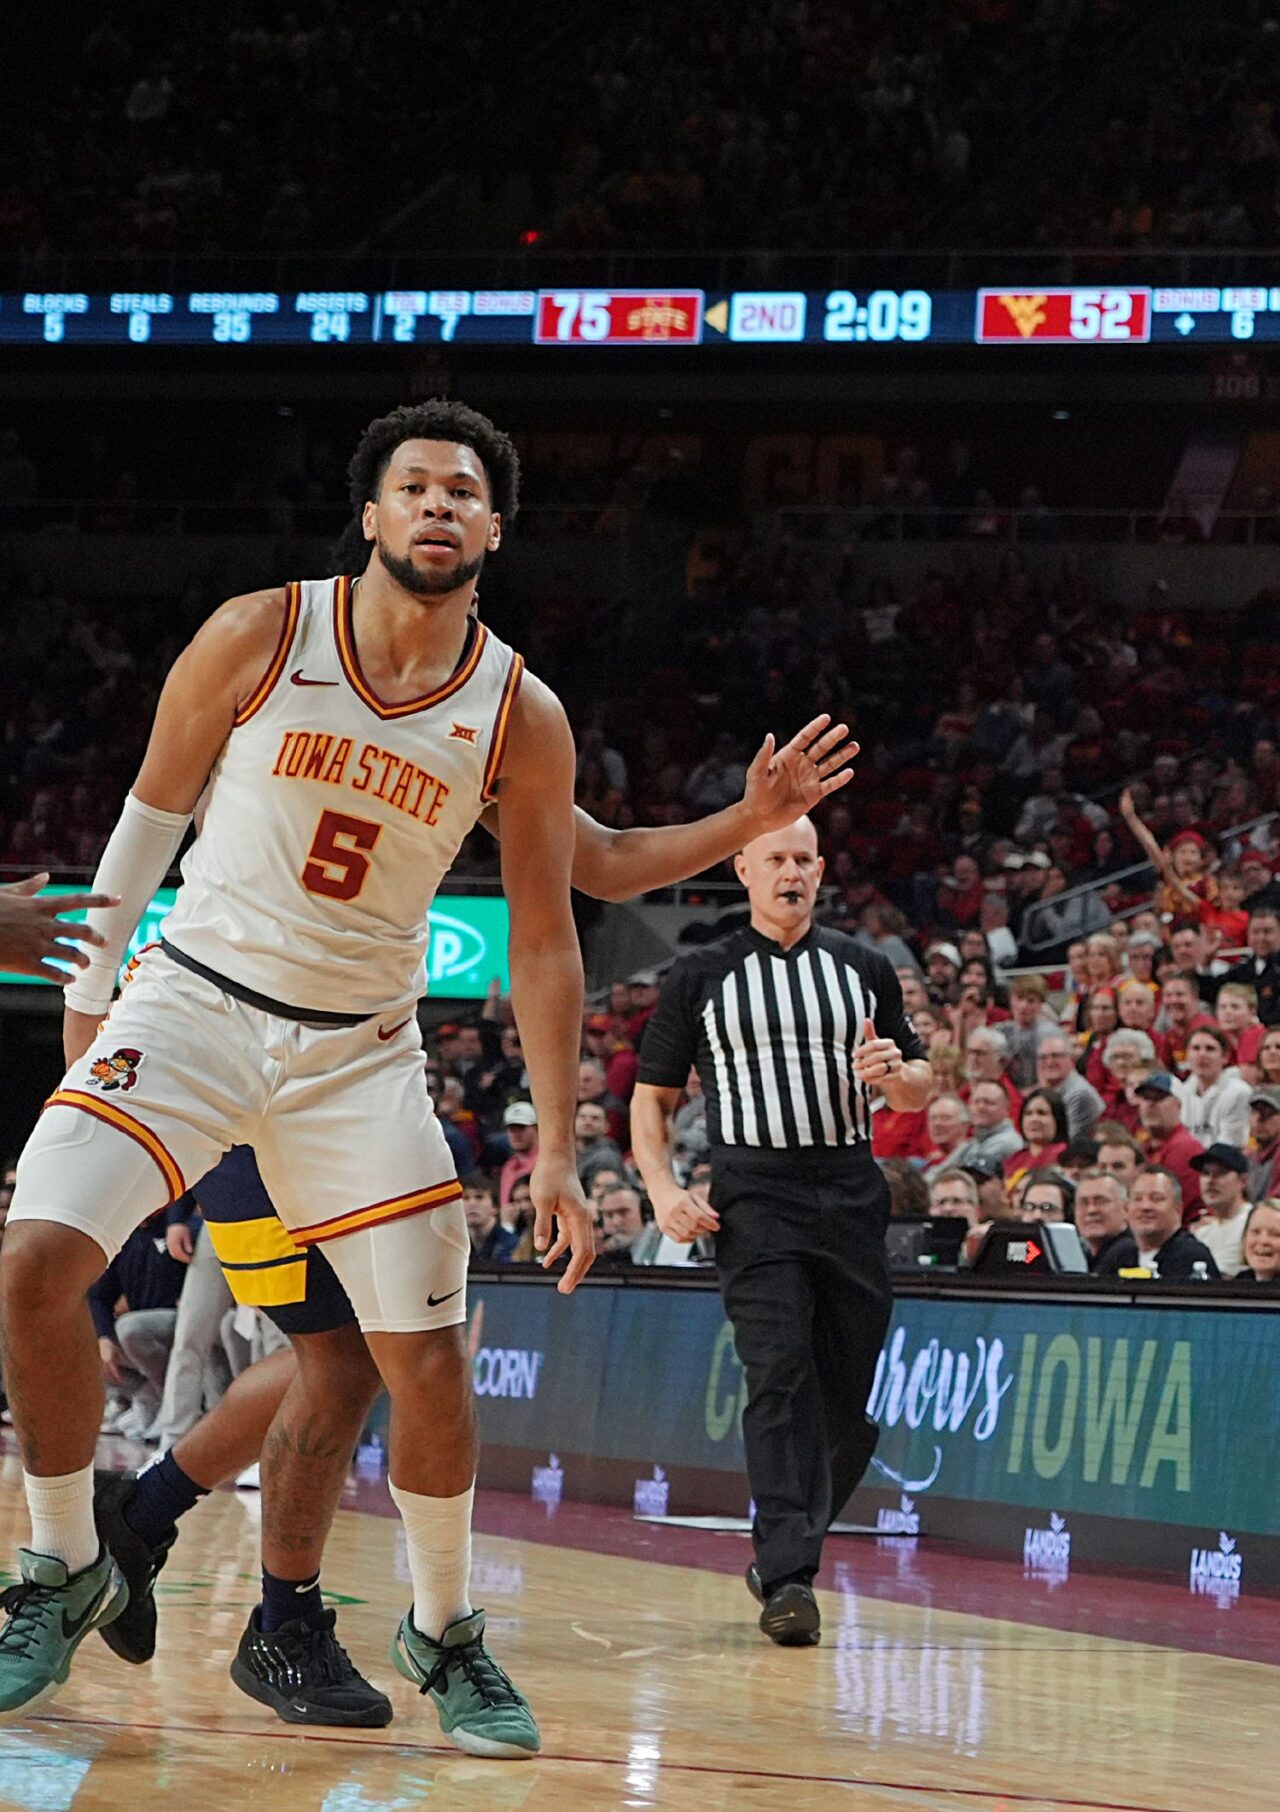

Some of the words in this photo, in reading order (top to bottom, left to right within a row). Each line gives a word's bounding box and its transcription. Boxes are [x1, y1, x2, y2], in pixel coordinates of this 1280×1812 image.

[44, 313, 64, 342] 5
[129, 313, 150, 342] 6
[213, 313, 250, 342] 35
[311, 312, 349, 342] 24
[393, 313, 416, 342] 2
[439, 313, 460, 342] 7
[110, 293, 173, 313] STEALS
[189, 293, 279, 313] REBOUNDS
[552, 293, 611, 341] 75
[739, 303, 798, 333] 2ND
[824, 290, 932, 342] 2:09
[1069, 291, 1132, 340] 52
[1231, 310, 1255, 339] 6
[272, 732, 353, 785] IOWA
[351, 743, 450, 827] STATE
[300, 808, 383, 902] 5
[866, 1326, 1013, 1440] rows
[1007, 1333, 1191, 1492] IOWA
